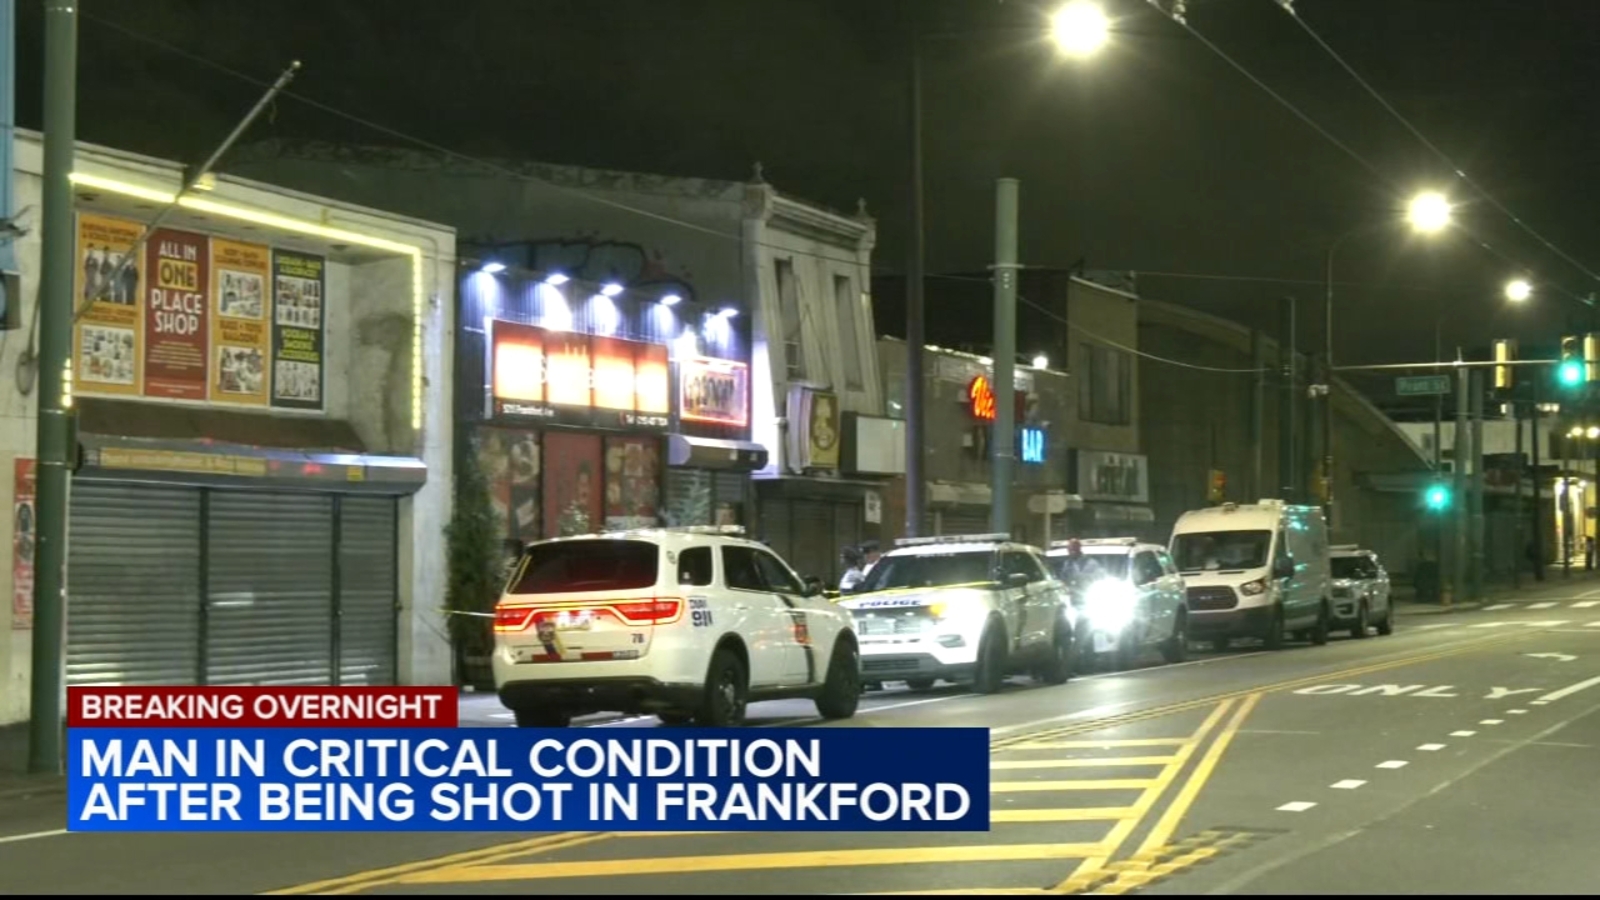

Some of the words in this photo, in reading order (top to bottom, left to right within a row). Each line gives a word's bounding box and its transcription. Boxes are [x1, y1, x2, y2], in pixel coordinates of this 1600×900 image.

[159, 240, 181, 259] ALL
[183, 245, 197, 261] IN
[160, 262, 196, 288] ONE
[151, 289, 203, 315] PLACE
[154, 311, 200, 335] SHOP
[1022, 428, 1044, 462] BAR
[858, 599, 922, 608] POLICE
[691, 610, 713, 627] 911
[1292, 684, 1545, 699] ONLY
